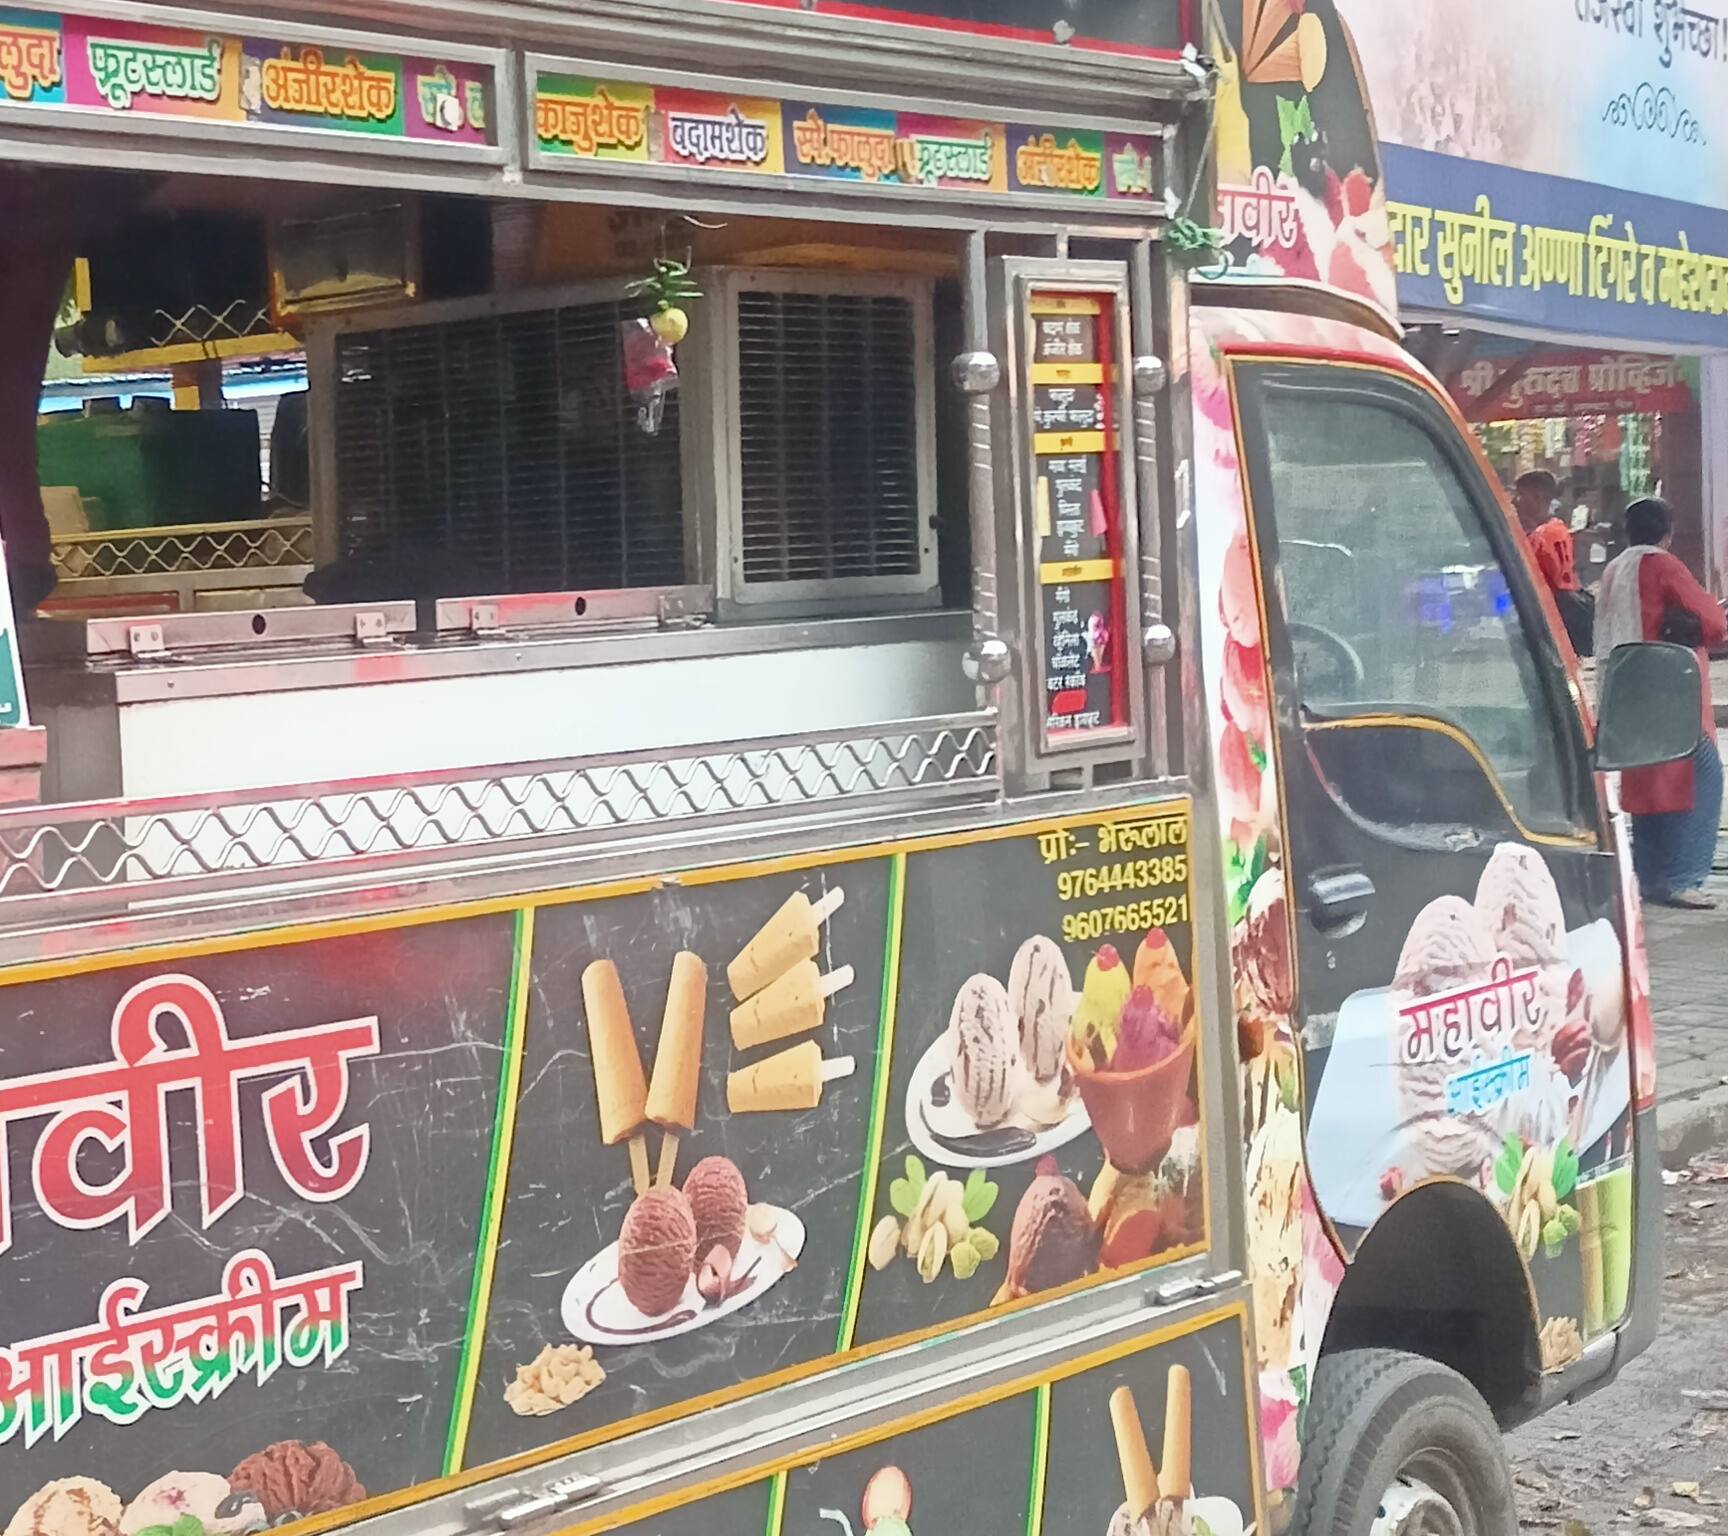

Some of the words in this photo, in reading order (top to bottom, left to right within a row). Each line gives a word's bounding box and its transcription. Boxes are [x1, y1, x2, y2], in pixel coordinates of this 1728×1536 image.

[1434, 193, 1517, 305] सुनील
[1520, 224, 1584, 297] अण्णा
[1056, 853, 1188, 902] 9764443385
[1061, 892, 1189, 944] 9607665521
[1398, 956, 1549, 1064] महावीर
